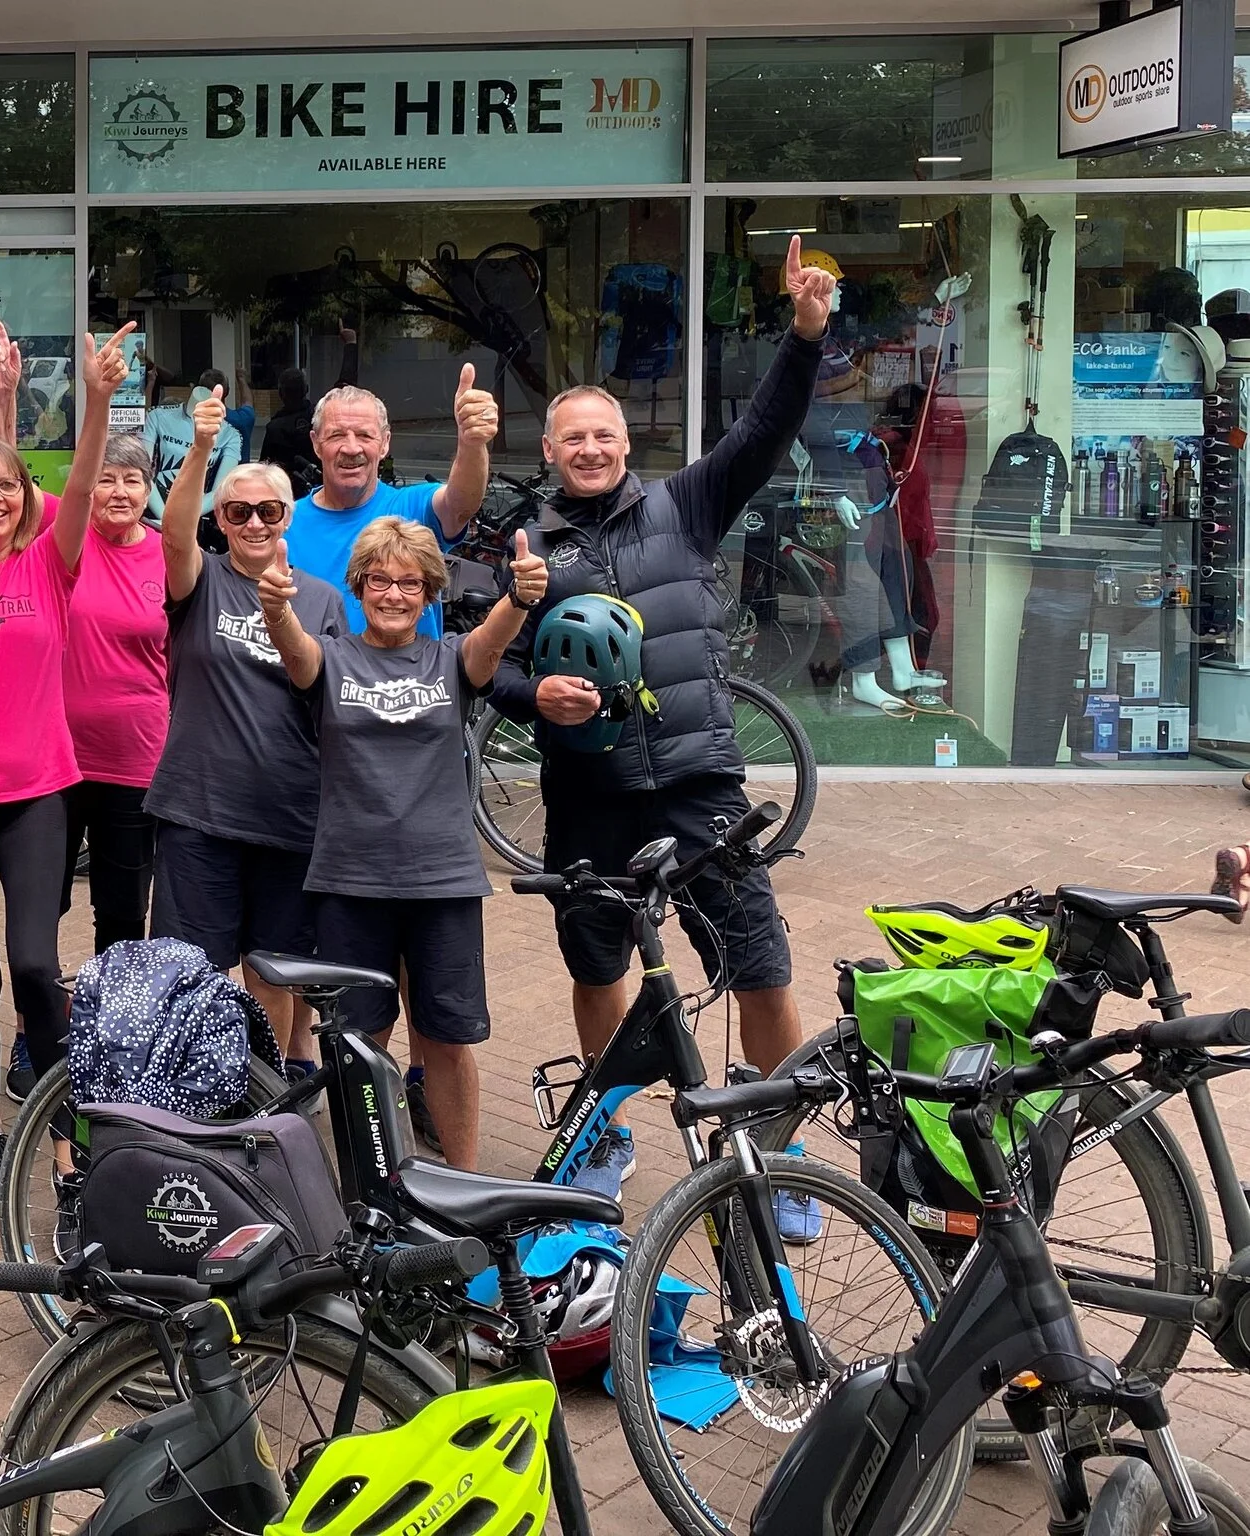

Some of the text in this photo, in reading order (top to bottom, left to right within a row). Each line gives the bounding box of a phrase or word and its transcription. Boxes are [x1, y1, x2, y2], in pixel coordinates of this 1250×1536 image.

[1108, 58, 1174, 97] OUTDOORS
[589, 78, 661, 113] MD
[1075, 74, 1100, 110] MD
[1113, 85, 1170, 108] outdoor sports store
[206, 78, 563, 139] BIKE HIRE
[104, 126, 188, 137] Kiwi Journeys
[318, 156, 447, 172] AVAILABLE HERE
[1106, 343, 1146, 355] tanka
[163, 435, 183, 446] NEW
[1042, 455, 1056, 516] NEW ZEALAND
[0, 600, 35, 614] TRAIL
[218, 614, 252, 640] GREAT
[340, 681, 451, 709] GREAT TASTE TRAIL
[362, 1084, 388, 1178] Kiwi Journeys
[544, 1088, 599, 1170] Kiwi Journeys
[163, 1172, 198, 1182] NELSON
[146, 1208, 218, 1226] Kiwi Journeys
[158, 1235, 208, 1254] NEW ZEALAND
[402, 1492, 456, 1536] GIRO
